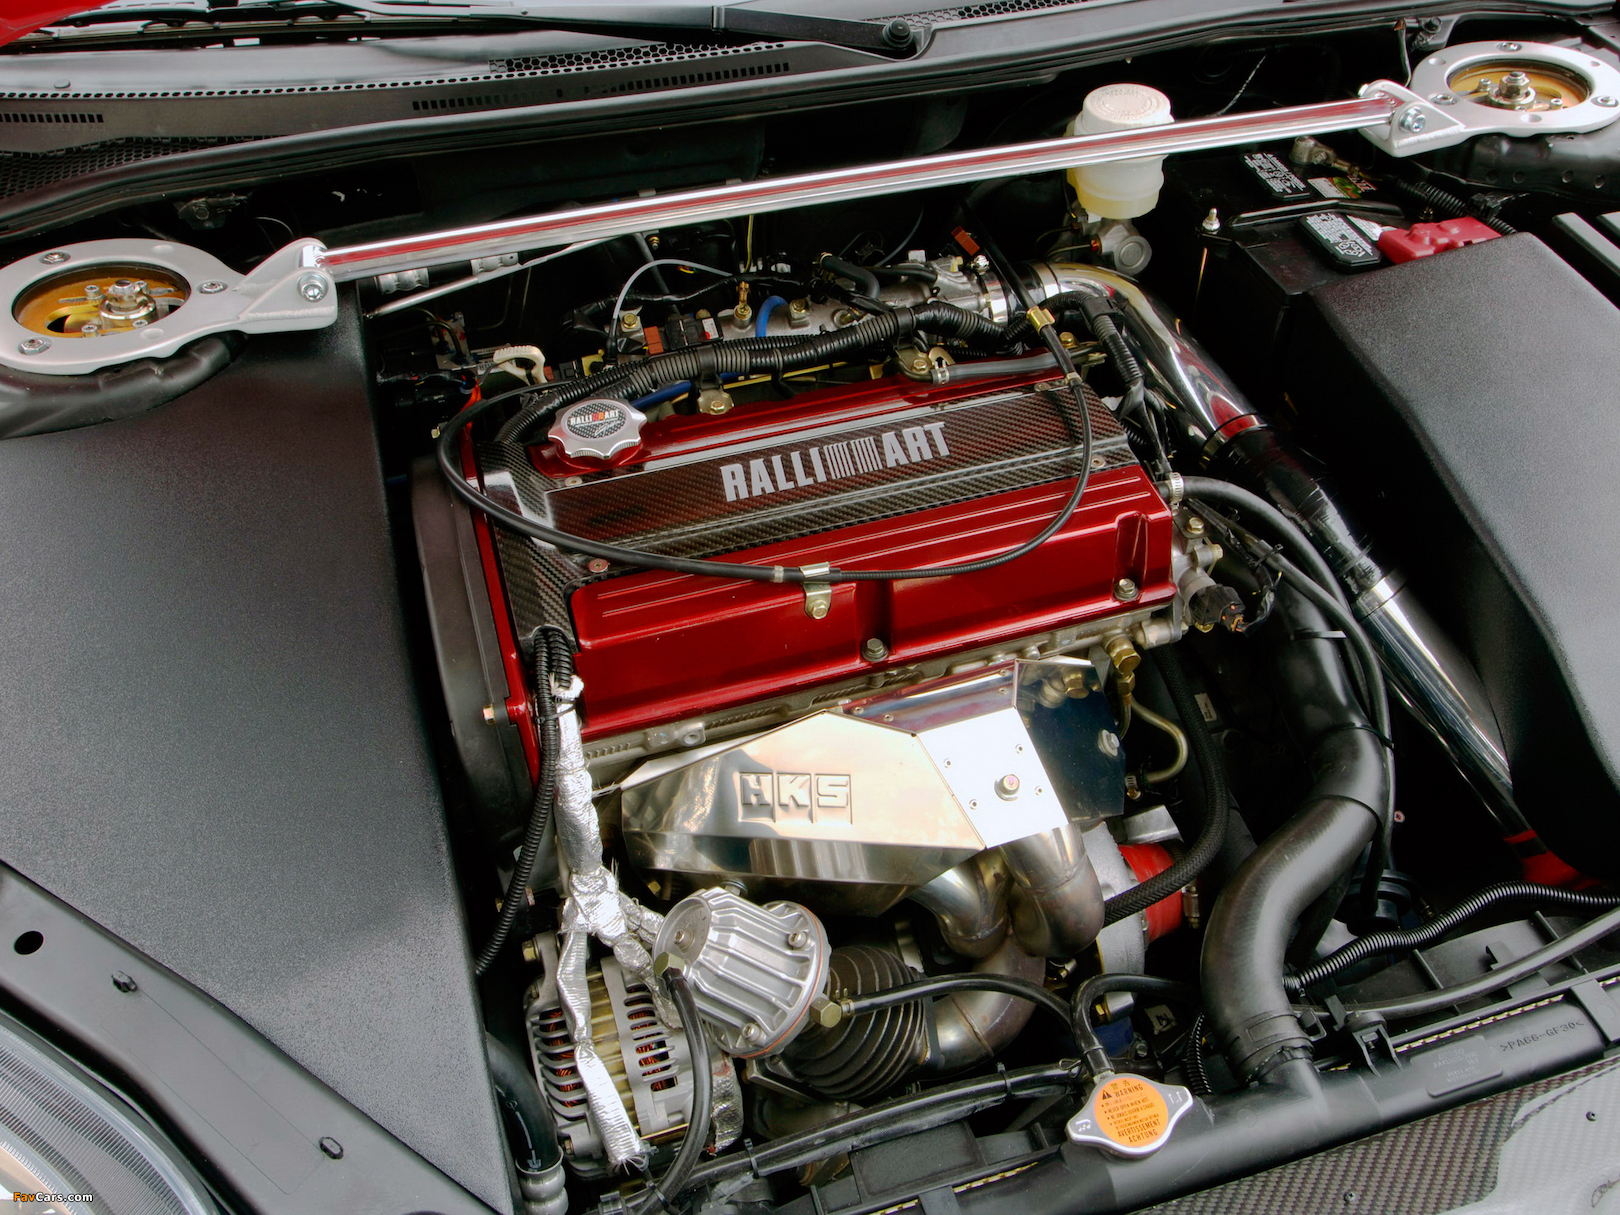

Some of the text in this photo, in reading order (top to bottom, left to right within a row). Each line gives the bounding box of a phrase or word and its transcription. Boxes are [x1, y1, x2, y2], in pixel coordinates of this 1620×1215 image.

[739, 771, 851, 810] HKS
[1114, 1083, 1143, 1098] WARNING
[1117, 1118, 1161, 1138] AVERTISSEMENT
[1128, 1128, 1158, 1143] ACHTUNG
